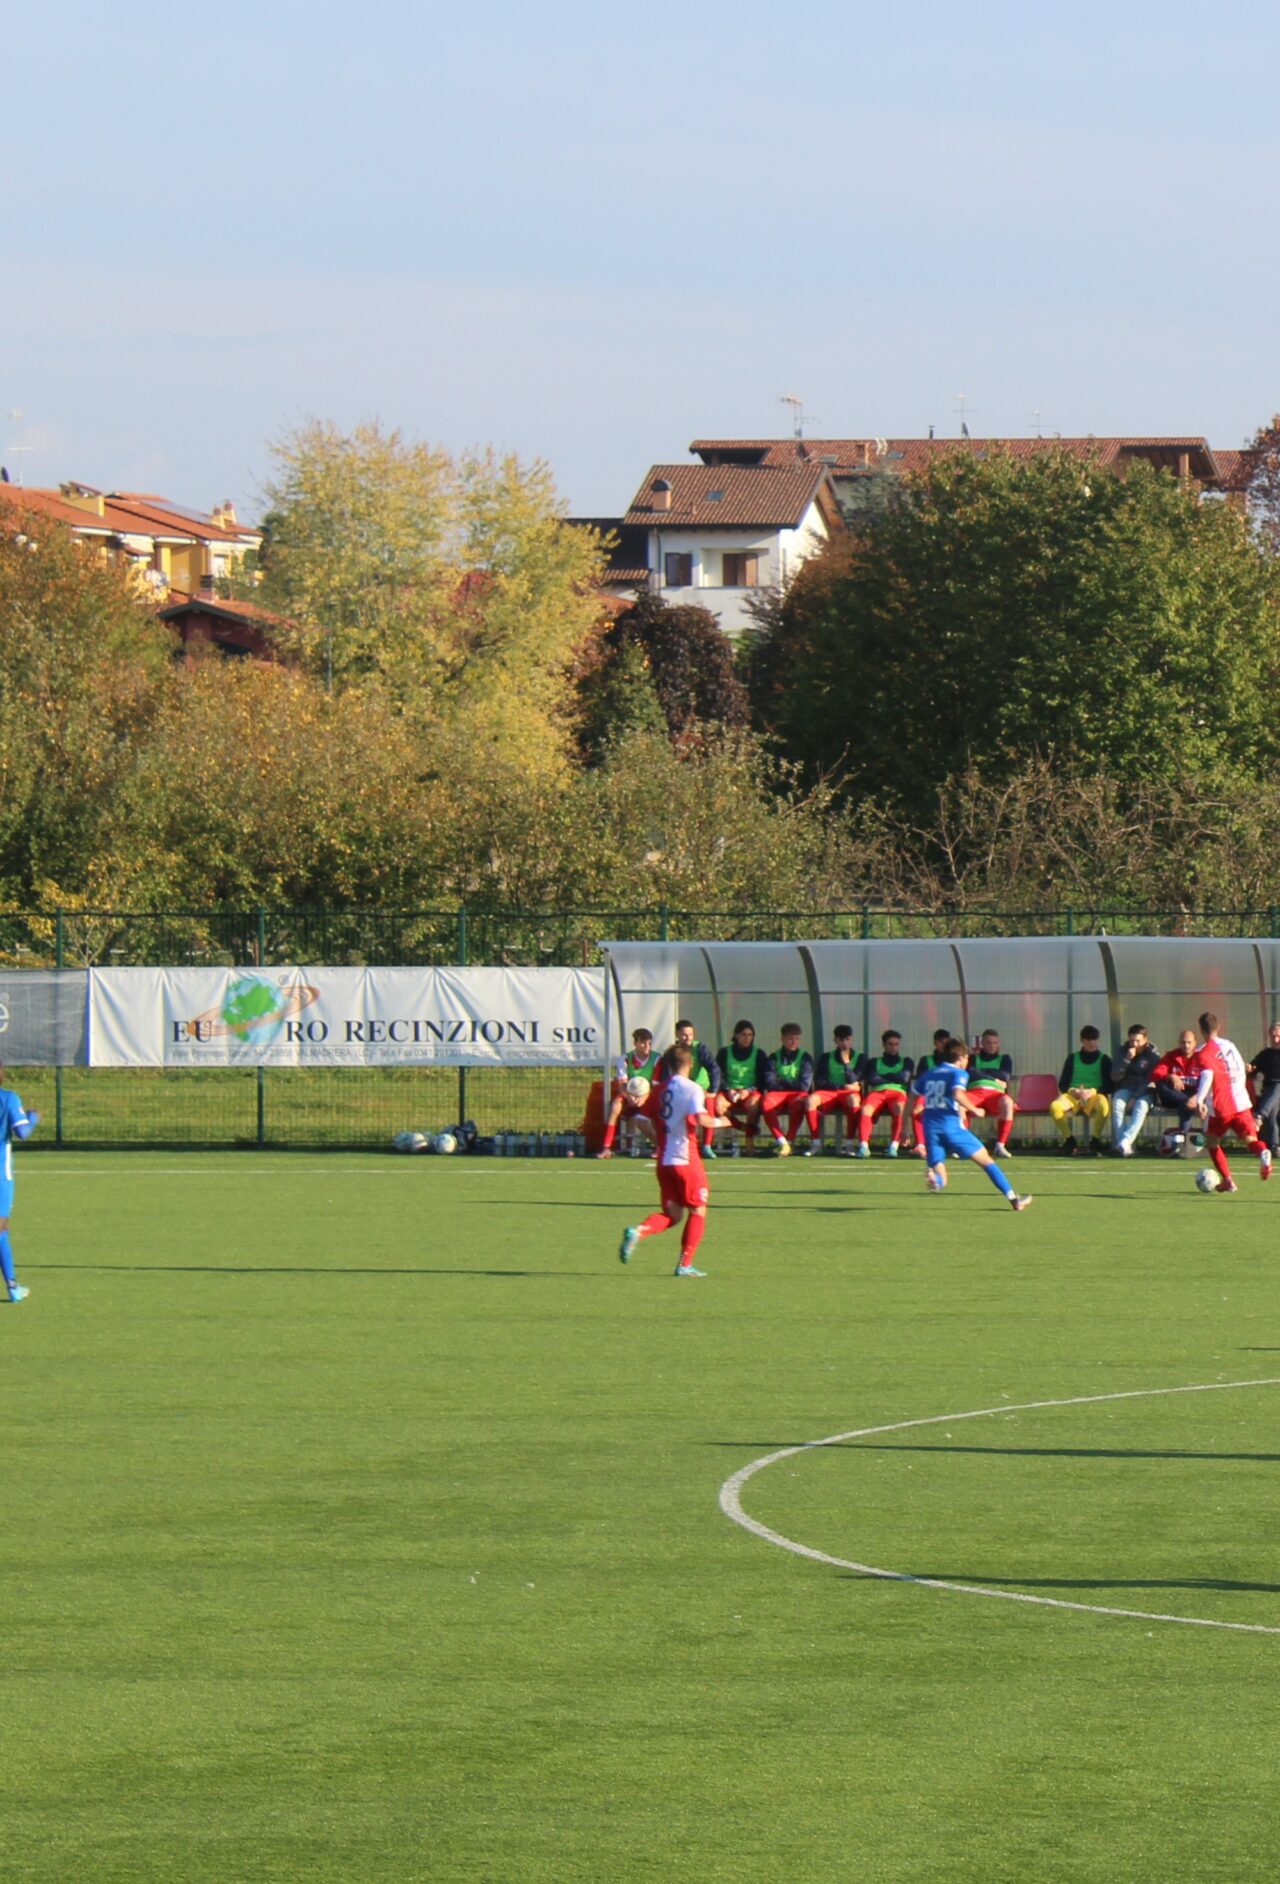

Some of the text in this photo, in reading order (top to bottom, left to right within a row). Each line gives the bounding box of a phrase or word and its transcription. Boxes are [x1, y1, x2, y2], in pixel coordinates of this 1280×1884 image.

[344, 1020, 541, 1042] RECINZIONI
[552, 1026, 597, 1042] snc
[659, 1089, 673, 1120] 8
